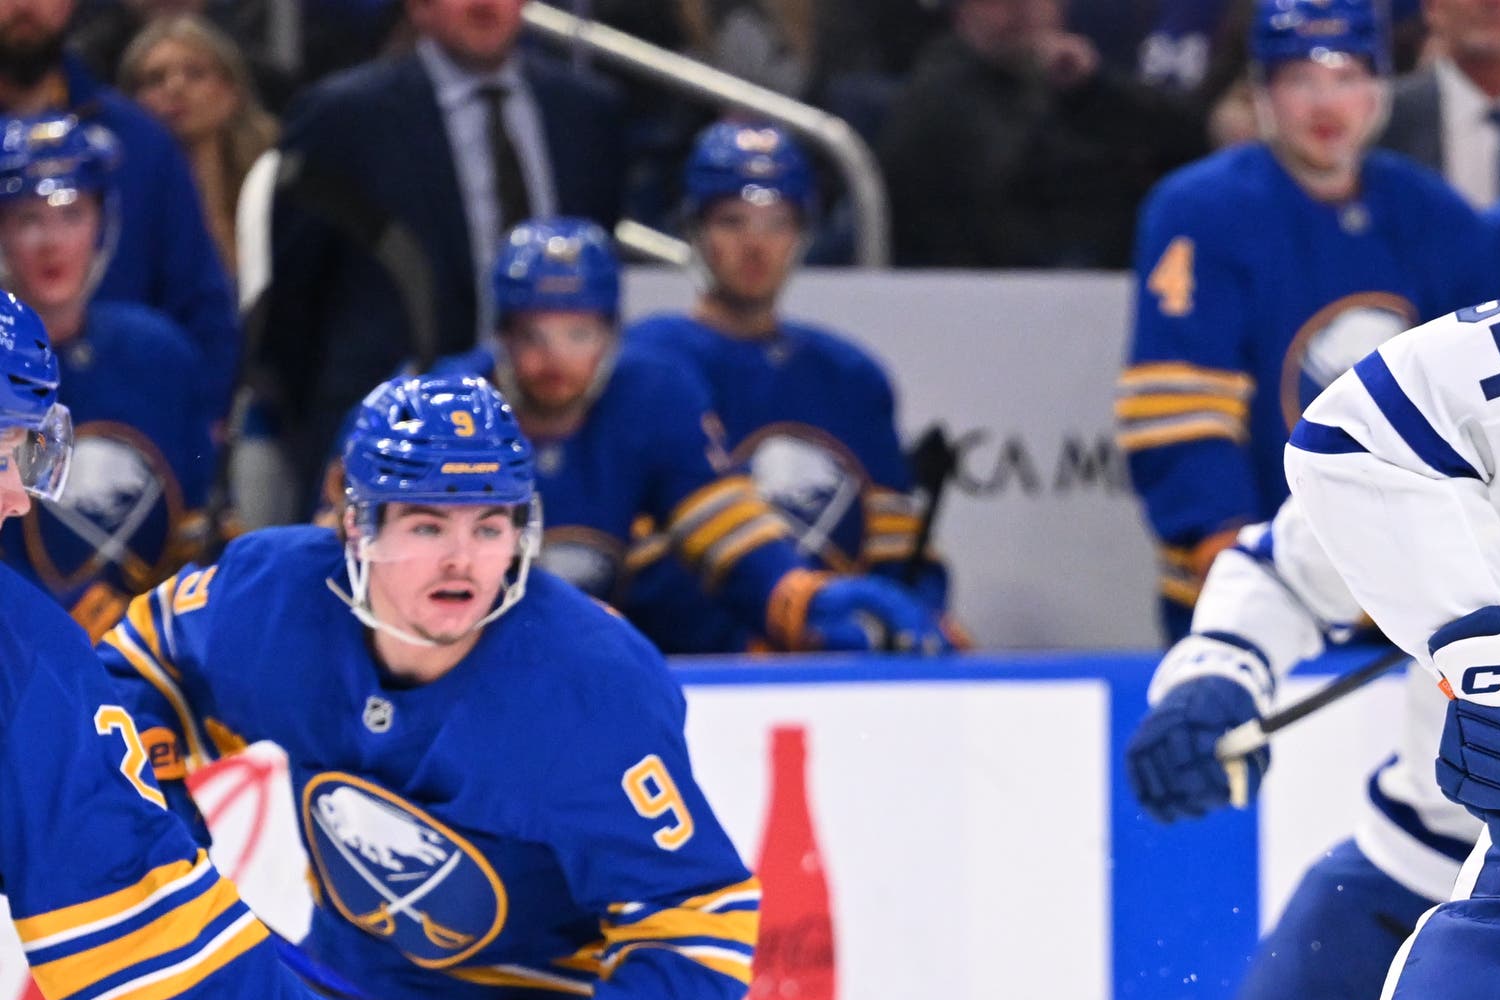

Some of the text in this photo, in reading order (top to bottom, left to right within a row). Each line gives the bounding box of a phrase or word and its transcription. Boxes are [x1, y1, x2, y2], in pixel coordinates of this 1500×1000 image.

[1147, 235, 1196, 317] 4
[449, 410, 476, 438] 9
[620, 753, 696, 852] 9
